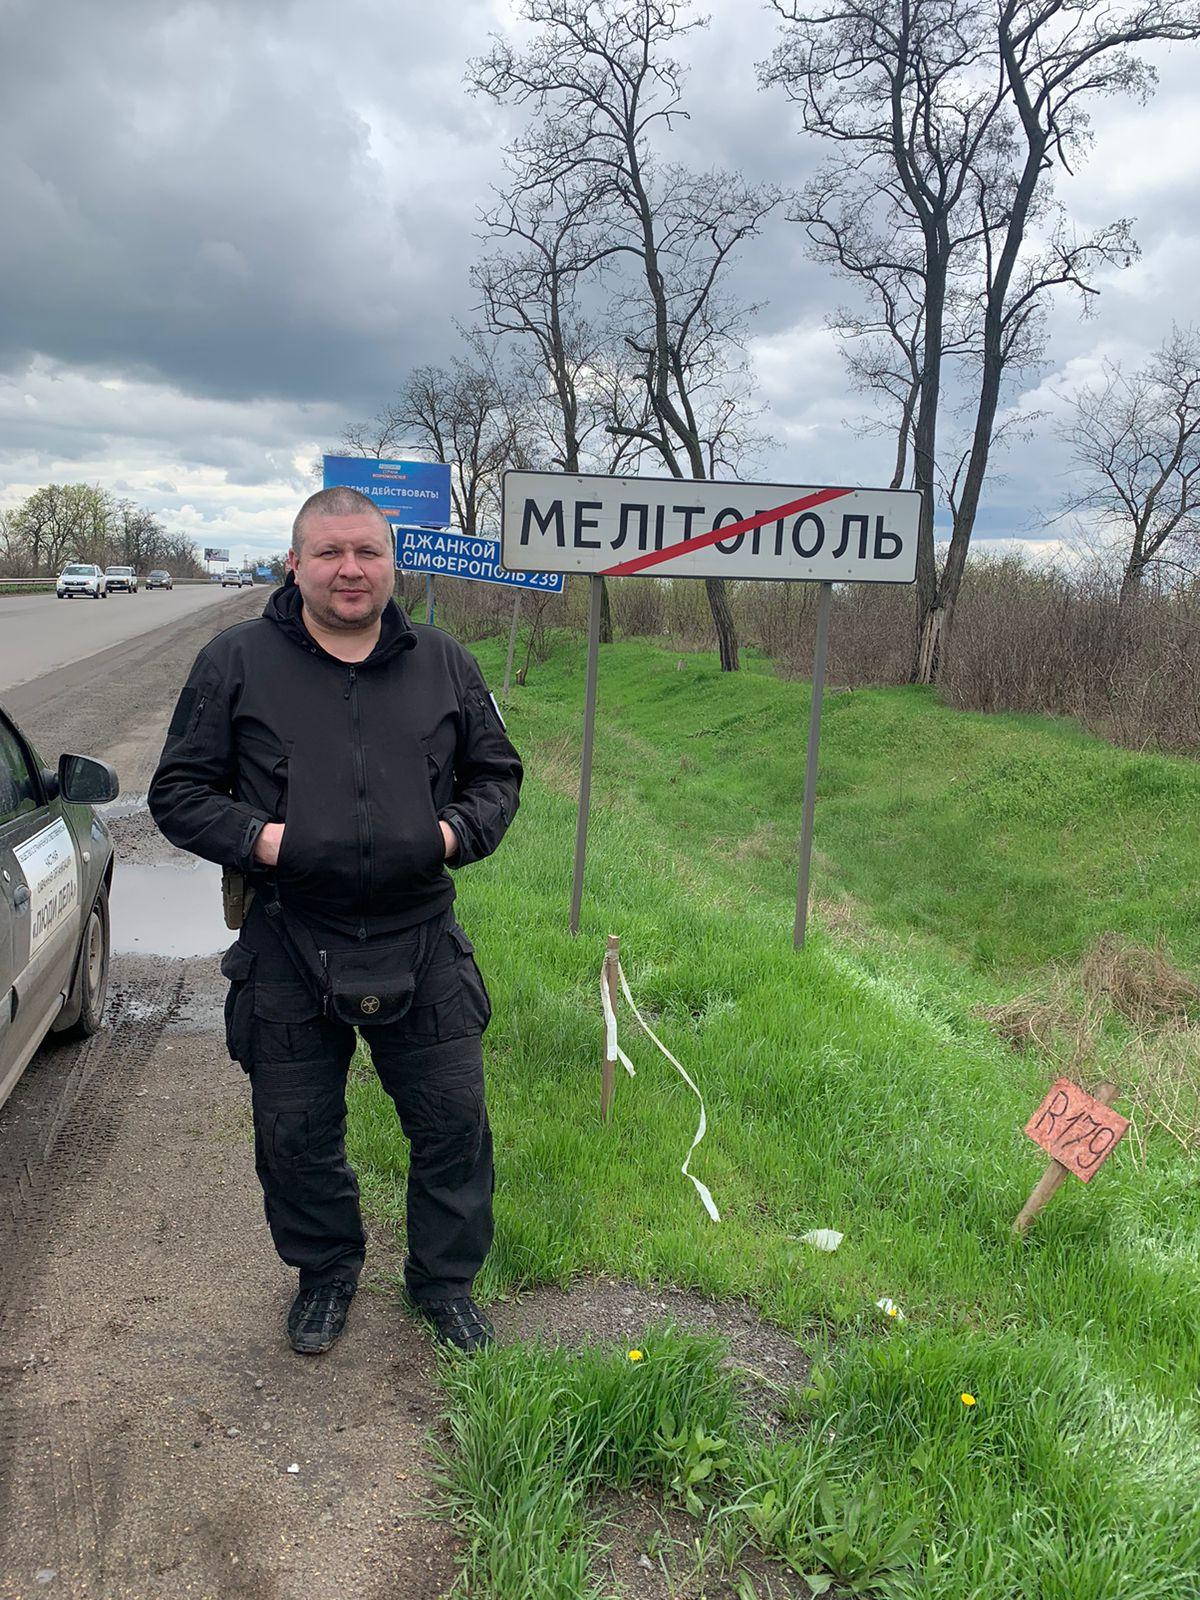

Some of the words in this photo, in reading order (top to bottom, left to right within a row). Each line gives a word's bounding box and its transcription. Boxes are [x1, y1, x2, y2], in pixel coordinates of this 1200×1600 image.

[371, 486, 439, 499] ДЕЙСТВОВАТЬ!
[519, 498, 903, 560] МЕЛІТОПОЛЬ
[402, 533, 496, 560] ДЖАНКОЙ
[529, 573, 559, 586] 239
[1034, 1090, 1115, 1169] R179
